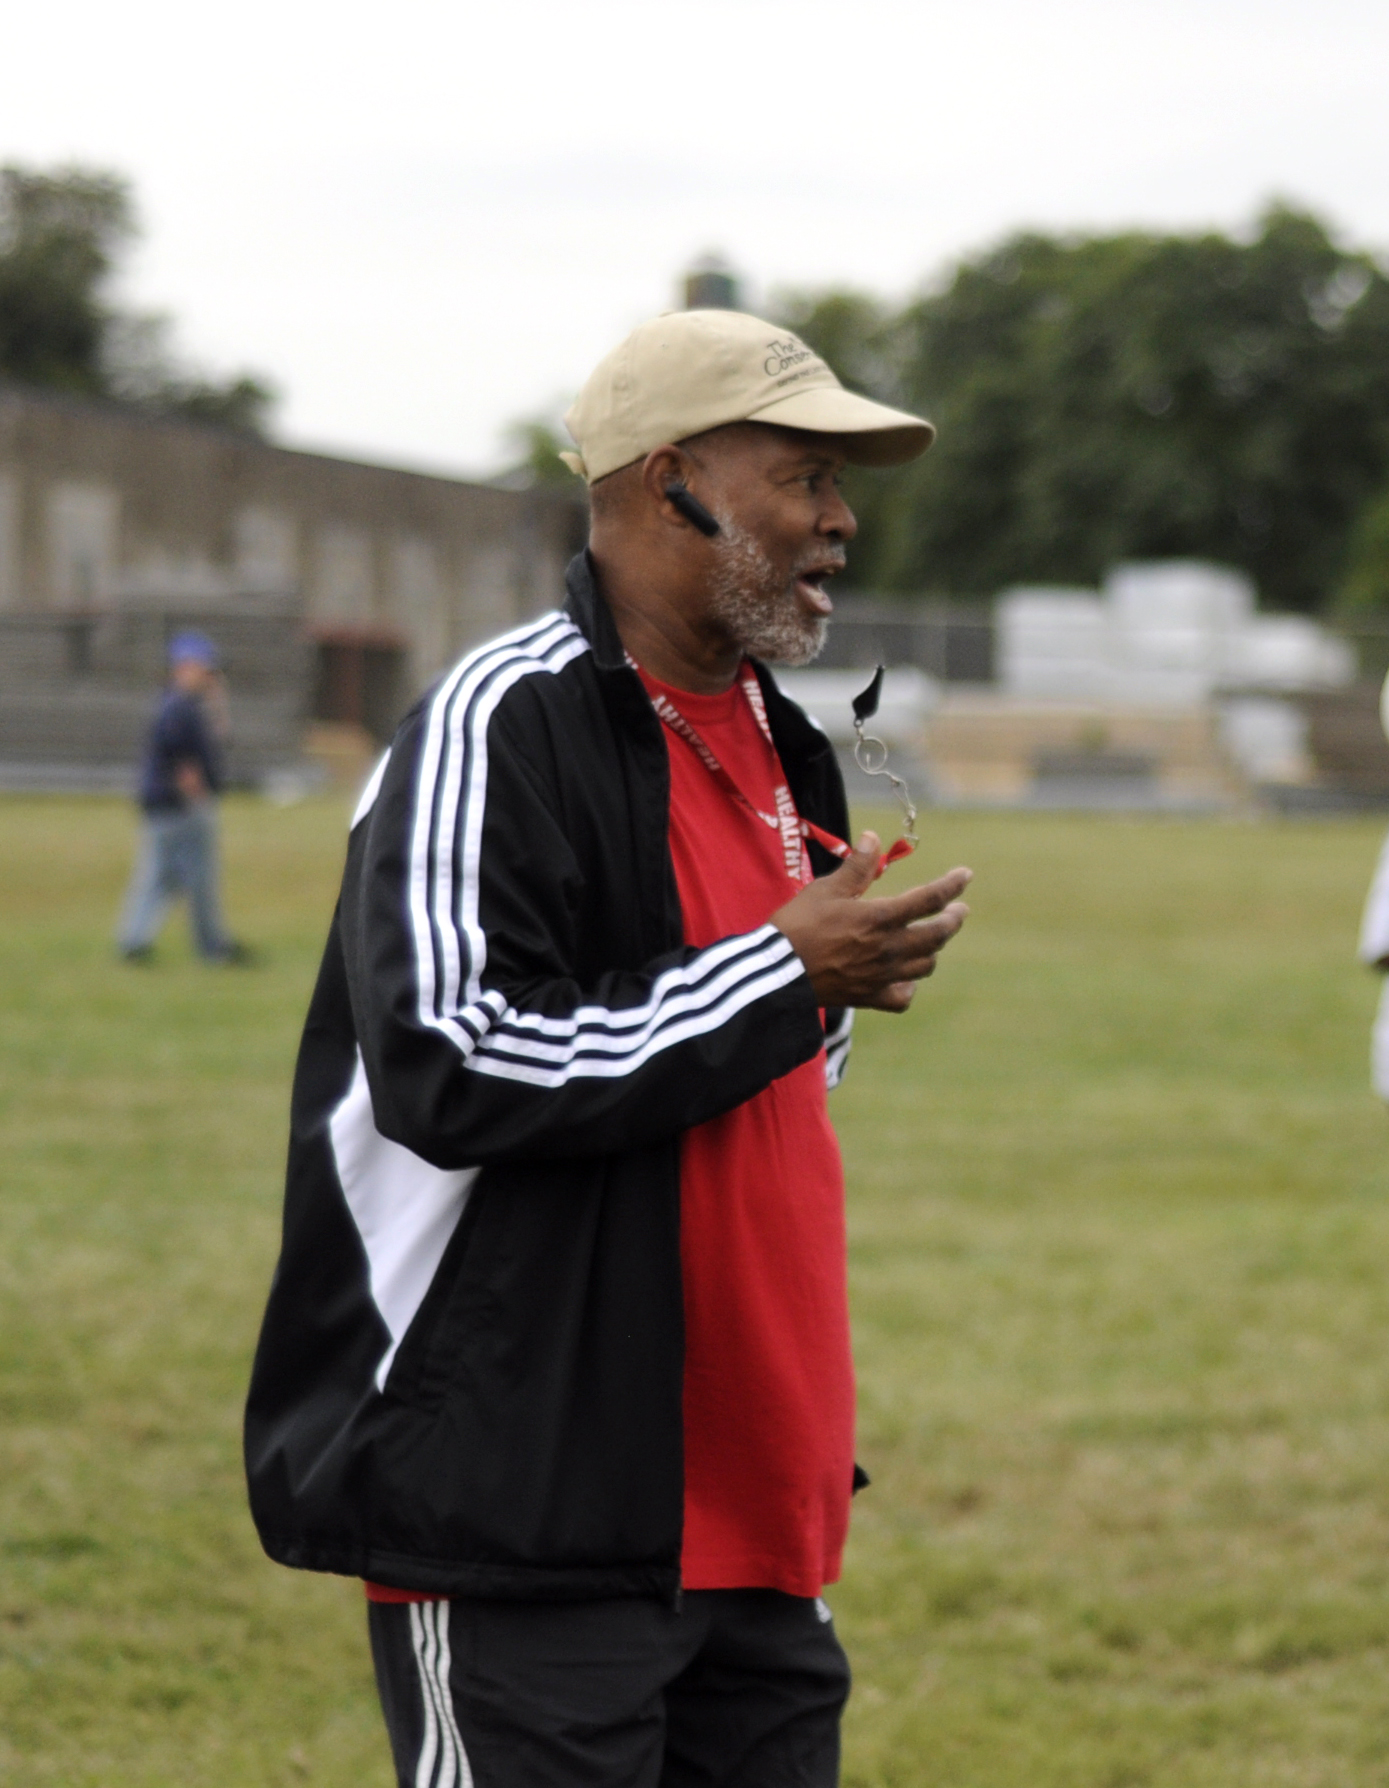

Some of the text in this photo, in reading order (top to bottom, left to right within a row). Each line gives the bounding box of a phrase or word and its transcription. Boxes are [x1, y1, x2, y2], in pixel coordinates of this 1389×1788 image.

[766, 340, 796, 358] The
[651, 694, 720, 771] HEALTHY
[774, 784, 801, 880] HEALTHY
